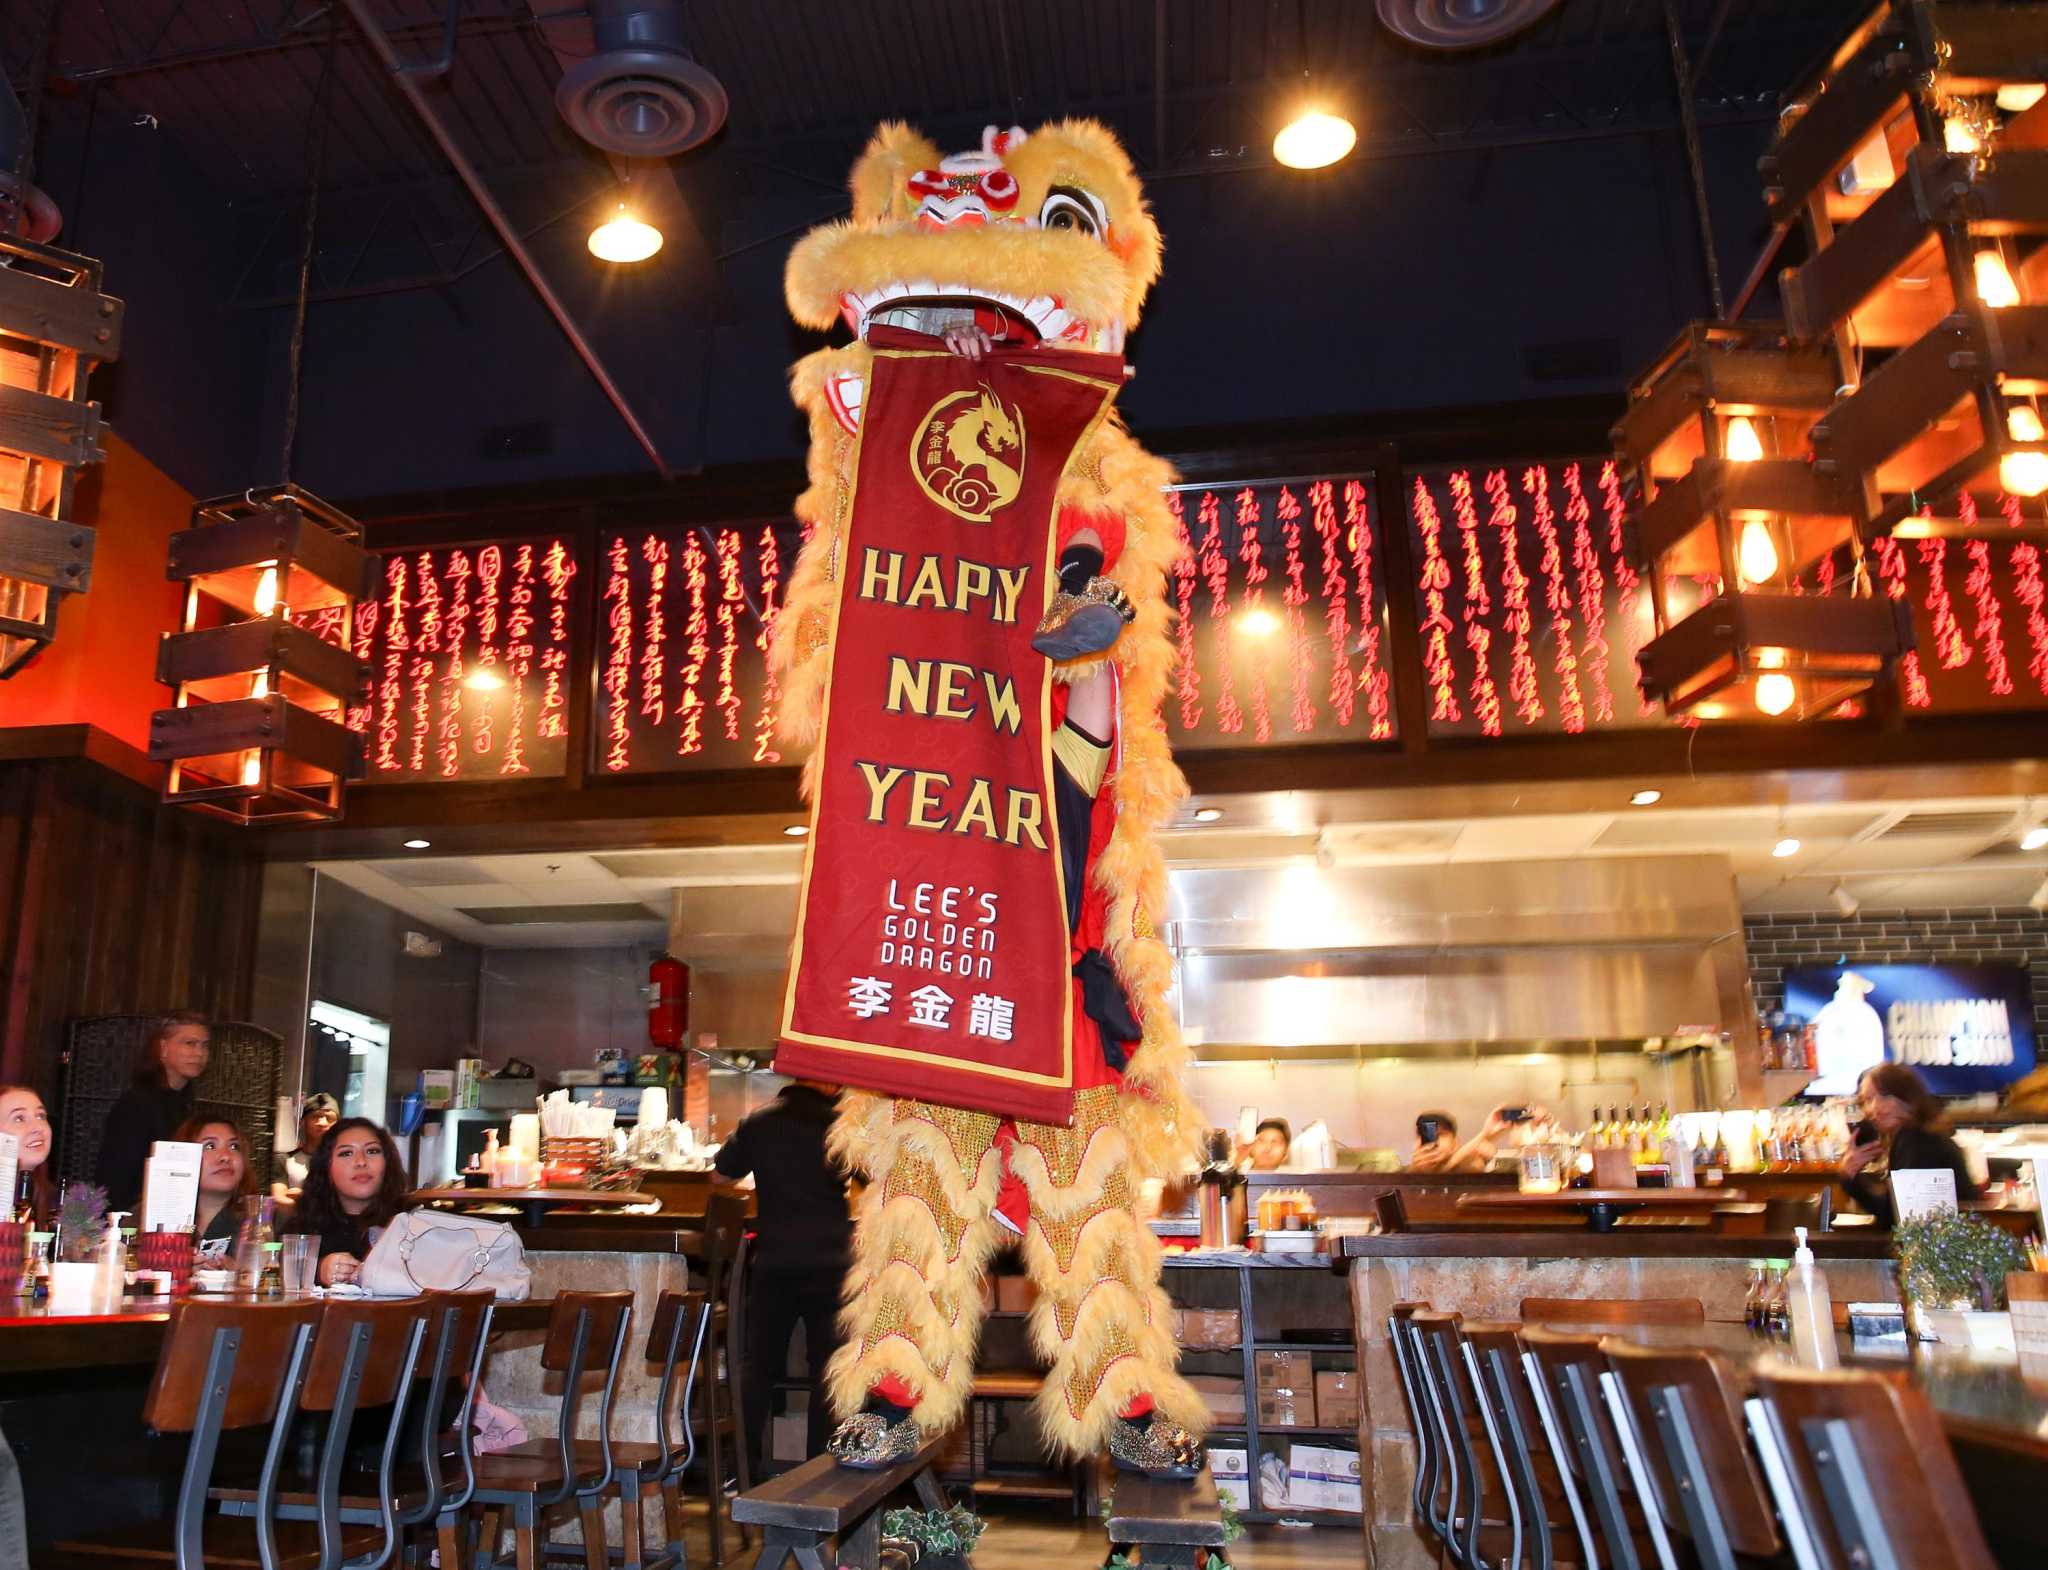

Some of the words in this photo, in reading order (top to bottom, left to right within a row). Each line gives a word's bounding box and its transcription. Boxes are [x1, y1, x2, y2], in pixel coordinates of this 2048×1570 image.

[927, 420, 946, 465] 李金龍
[860, 547, 1031, 623] HAPY
[885, 656, 1022, 735] NEW
[857, 761, 1049, 850] YEAR
[888, 878, 999, 924] LEE'S
[880, 941, 993, 980] DRAGON
[884, 914, 995, 952] GOLDEN
[848, 976, 1015, 1042] 李金龍
